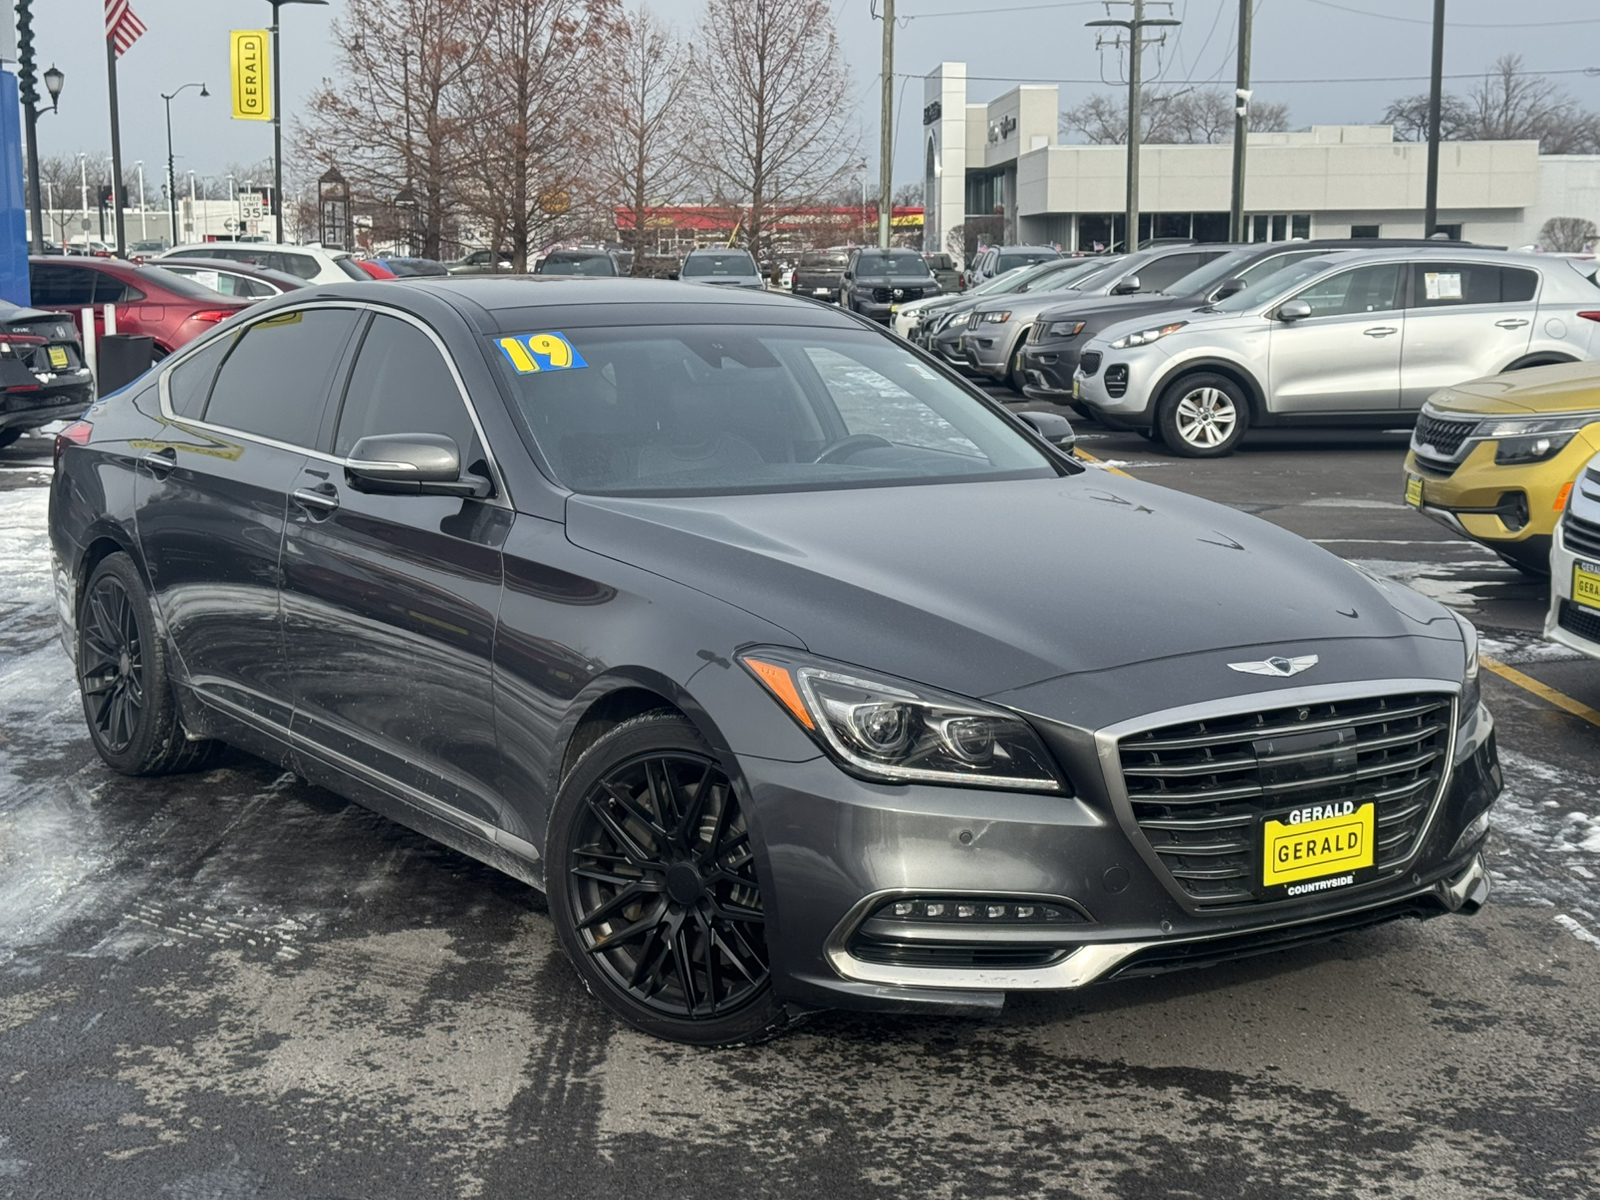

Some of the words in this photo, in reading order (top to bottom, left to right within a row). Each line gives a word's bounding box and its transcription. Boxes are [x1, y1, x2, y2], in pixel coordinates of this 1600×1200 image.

[244, 41, 257, 108] GERALD
[242, 207, 261, 218] 35
[500, 334, 572, 372] 19
[1289, 801, 1354, 825] GERALD
[1278, 832, 1358, 863] GERALD
[1287, 876, 1354, 896] COUNTRYSIDE
